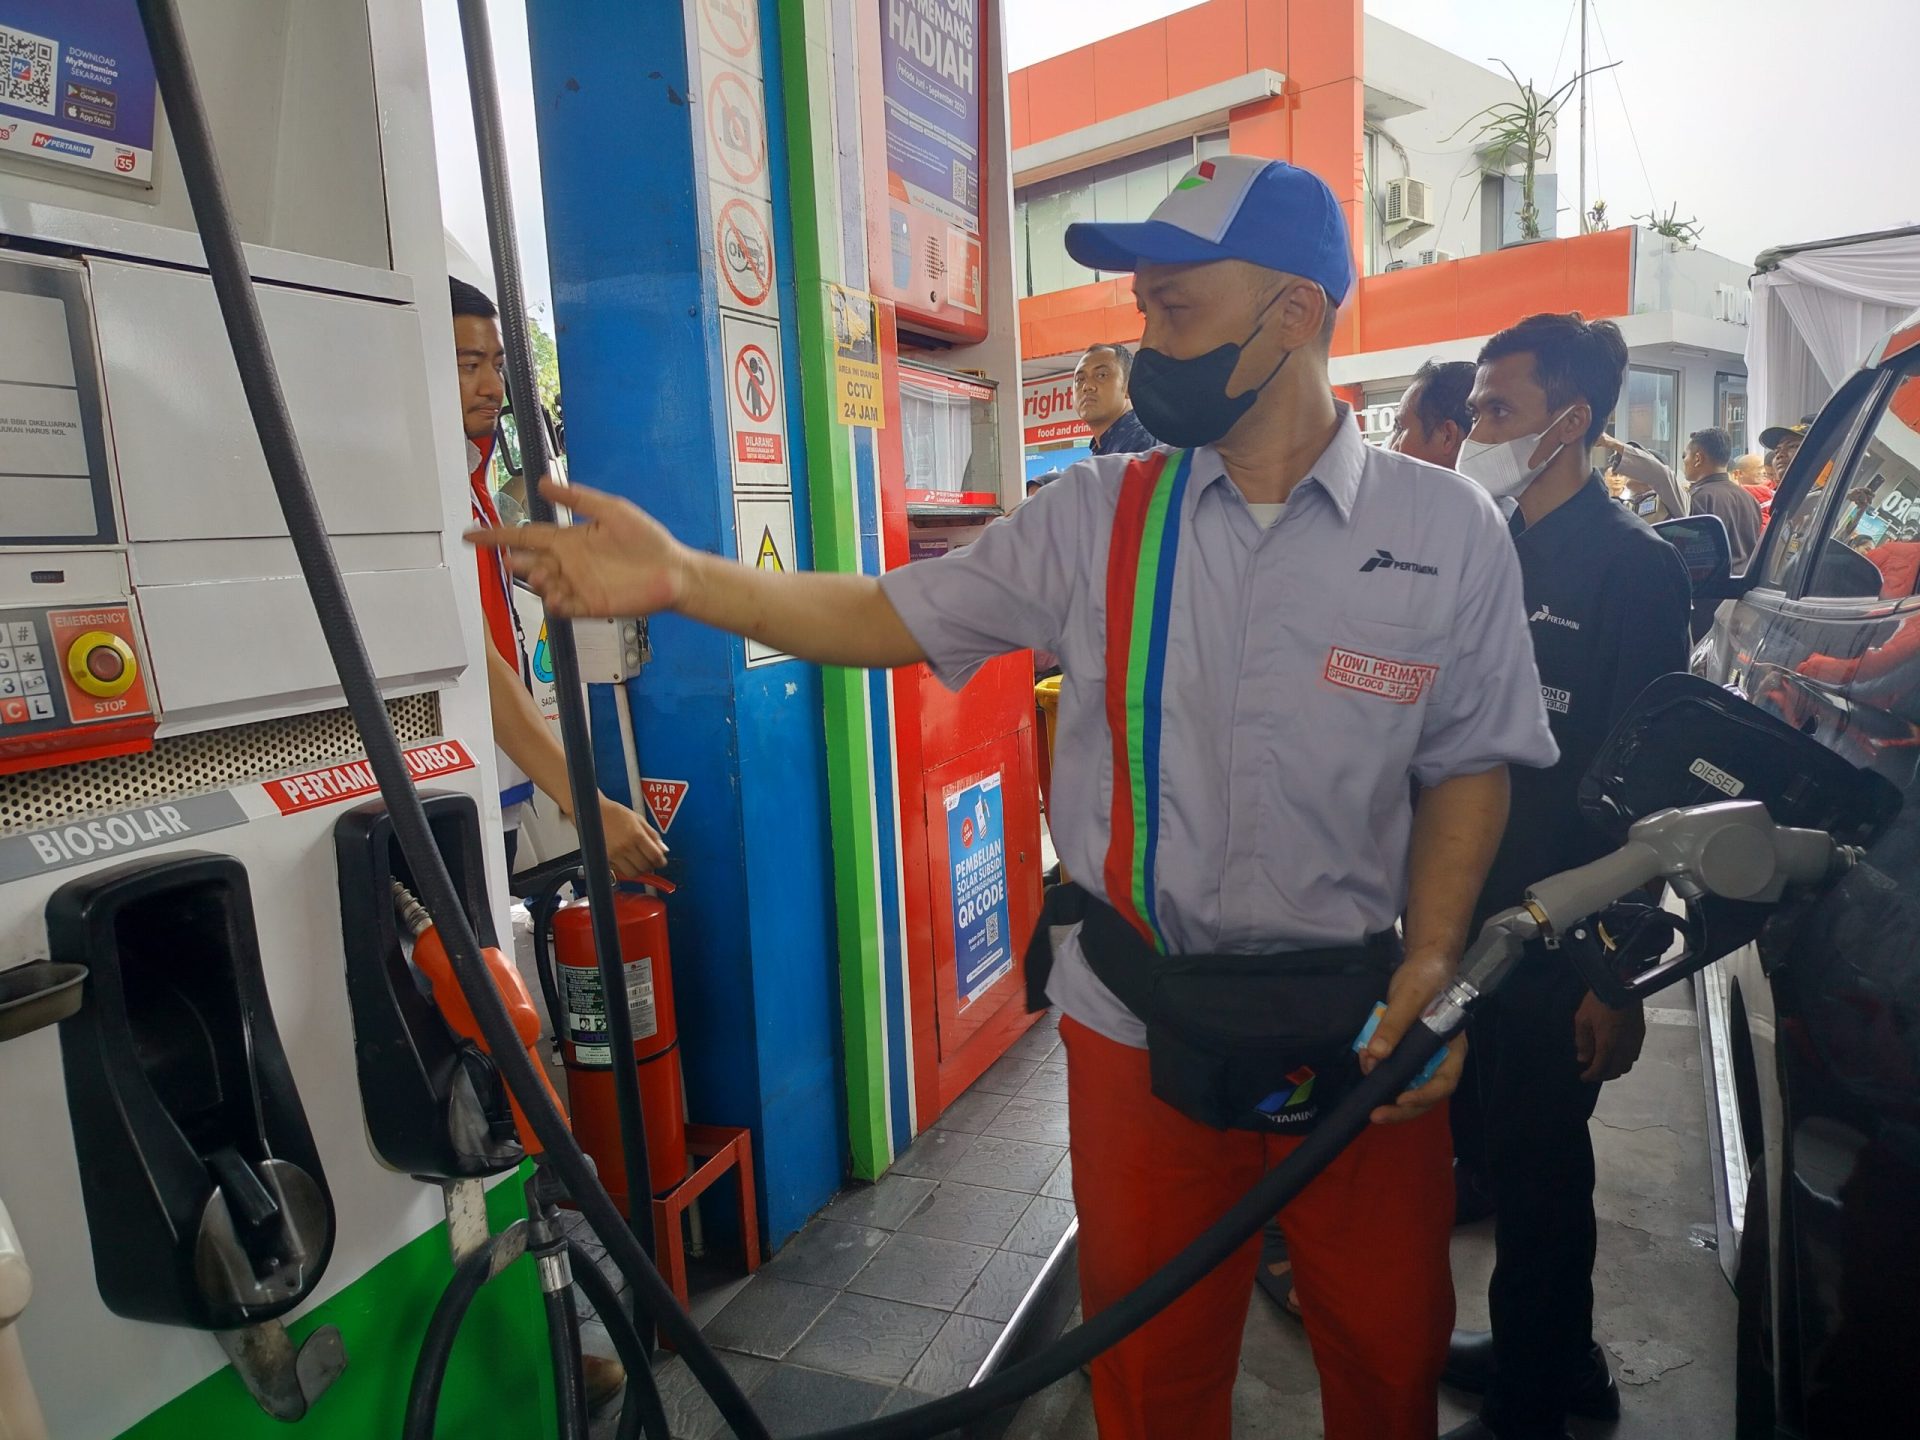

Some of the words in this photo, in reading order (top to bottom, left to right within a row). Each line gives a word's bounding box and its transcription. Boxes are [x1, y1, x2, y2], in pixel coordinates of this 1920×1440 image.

[69, 46, 116, 67] DOWNLOAD
[889, 0, 973, 96] HADIAH
[65, 55, 118, 78] MyPertamina
[70, 67, 112, 85] SEKARANG
[80, 112, 93, 123] App
[93, 115, 111, 126] Store
[115, 157, 133, 170] 135
[847, 381, 872, 400] CCTV
[844, 402, 856, 419] 24
[859, 404, 878, 422] JAM
[25, 427, 50, 435] HARUS
[28, 419, 77, 429] DIKELUARKAN
[1037, 428, 1055, 438] food
[1056, 424, 1071, 436] and
[745, 436, 774, 448] DILARANG
[55, 612, 126, 628] EMERGENCY
[3, 677, 15, 694] 3
[1328, 668, 1355, 684] SPBU
[1357, 677, 1384, 690] COCO
[6, 702, 23, 718] C
[94, 699, 128, 714] STOP
[403, 744, 461, 776] URBO
[1691, 761, 1737, 796] DIESEL
[649, 783, 676, 795] APAR
[654, 795, 672, 812] 12
[28, 805, 191, 864] BIOSOLAR
[955, 838, 1002, 881] PEMBELIAN
[957, 873, 978, 896] SOLAR
[979, 855, 1002, 880] SUBSIDI
[958, 900, 975, 929] QR
[976, 879, 1004, 916] CODE
